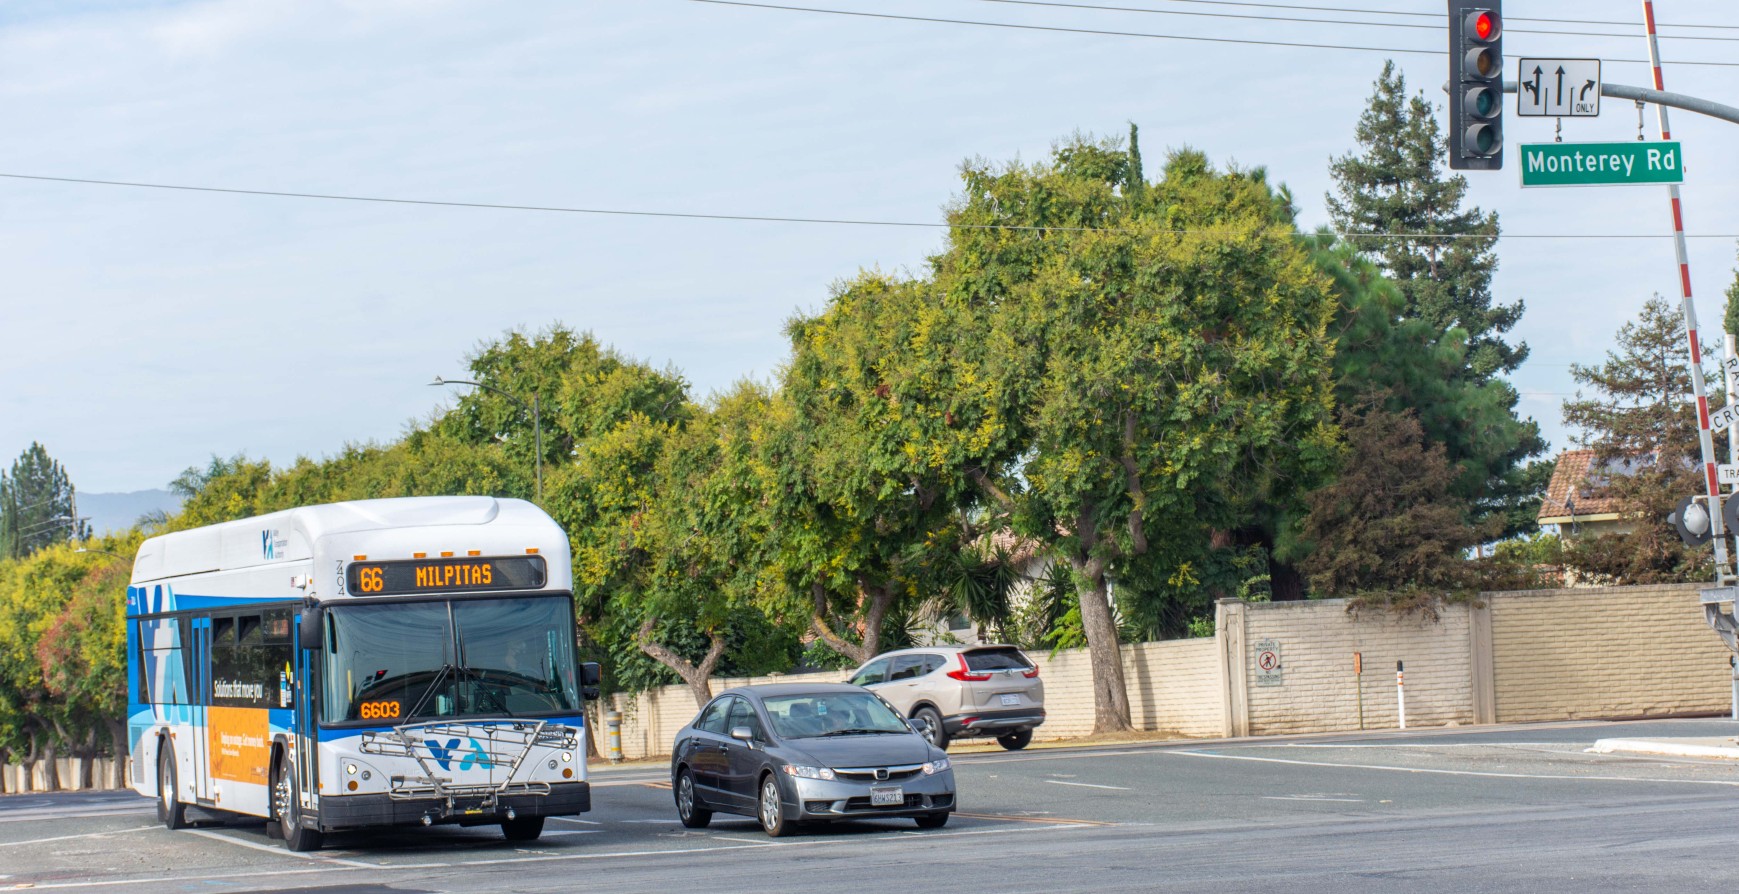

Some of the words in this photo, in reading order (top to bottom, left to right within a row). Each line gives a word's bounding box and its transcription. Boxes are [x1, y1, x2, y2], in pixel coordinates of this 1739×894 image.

[1575, 103, 1595, 114] ONLY
[1528, 151, 1635, 176] Monterey
[1648, 149, 1675, 171] Rd
[336, 560, 345, 596] 7404
[360, 567, 383, 592] 66
[416, 563, 492, 587] MILPITAS
[214, 680, 233, 698] Solutions
[233, 680, 241, 698] that
[242, 684, 254, 699] move
[254, 684, 263, 704] you
[360, 701, 400, 719] 6603
